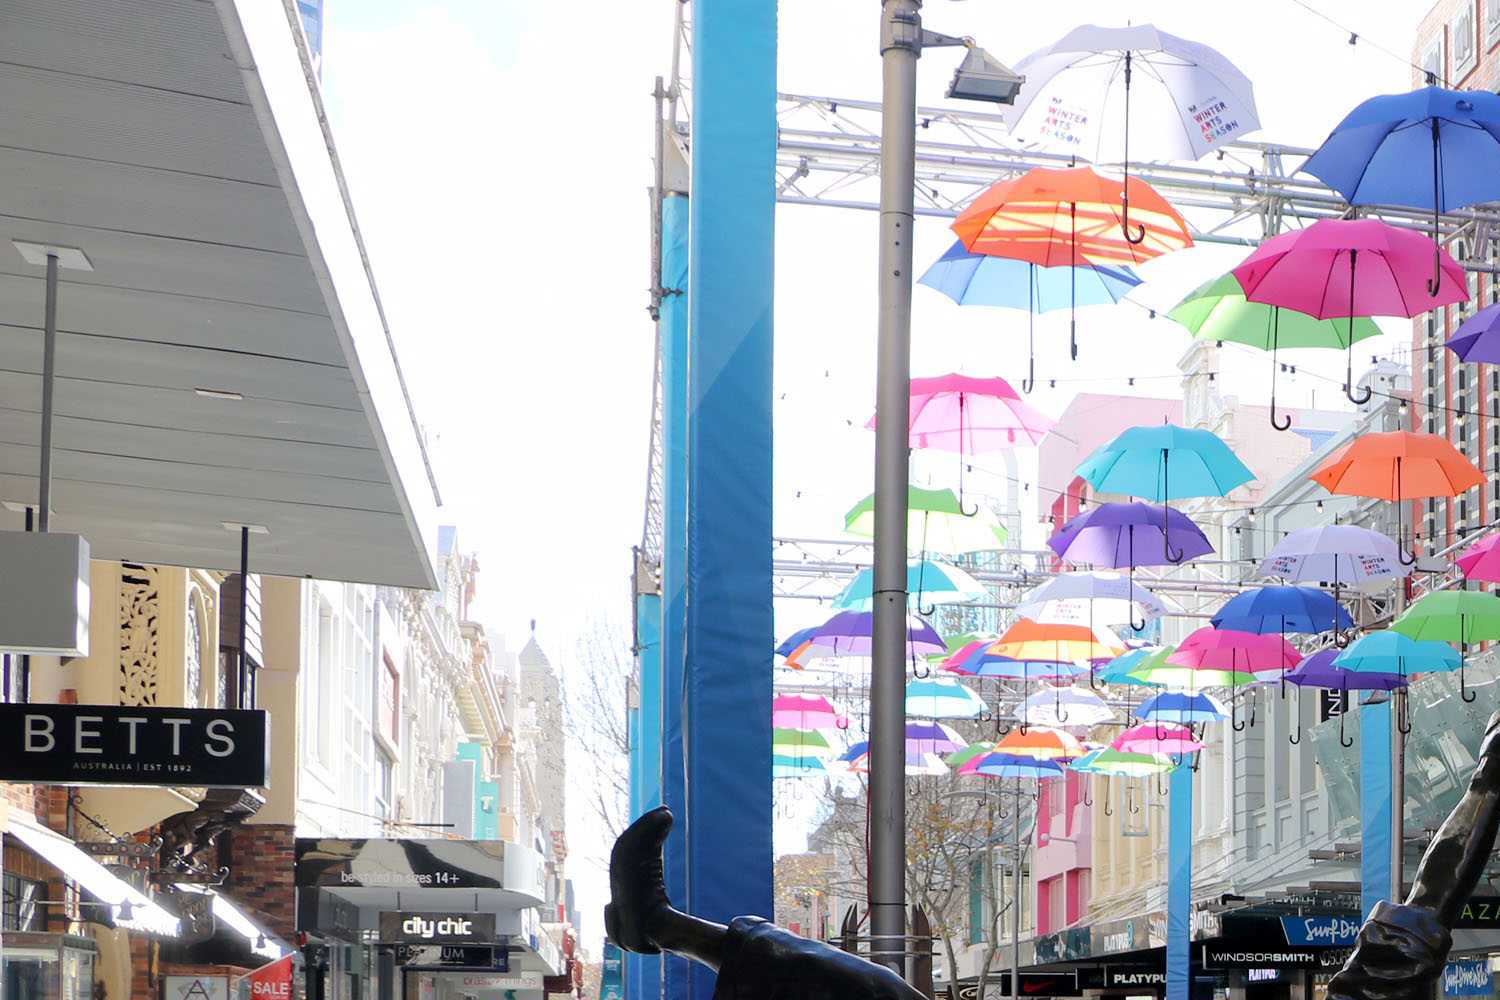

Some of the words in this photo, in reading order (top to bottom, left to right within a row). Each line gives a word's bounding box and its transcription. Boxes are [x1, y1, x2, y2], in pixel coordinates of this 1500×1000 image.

[1048, 106, 1088, 125] WINTER
[1193, 101, 1227, 124] WINTER
[1044, 117, 1071, 131] ARTS
[1200, 116, 1223, 133] ARTS
[1203, 120, 1239, 144] SEASON
[24, 714, 236, 757] BETTS
[73, 762, 132, 771] AUSTRALIA
[143, 763, 162, 771] EST
[405, 872, 432, 884] sizes
[435, 872, 460, 884] 14+
[403, 917, 433, 938] city
[438, 917, 472, 935] chic
[1113, 973, 1167, 984] PLATYPU
[253, 981, 289, 995] SALE
